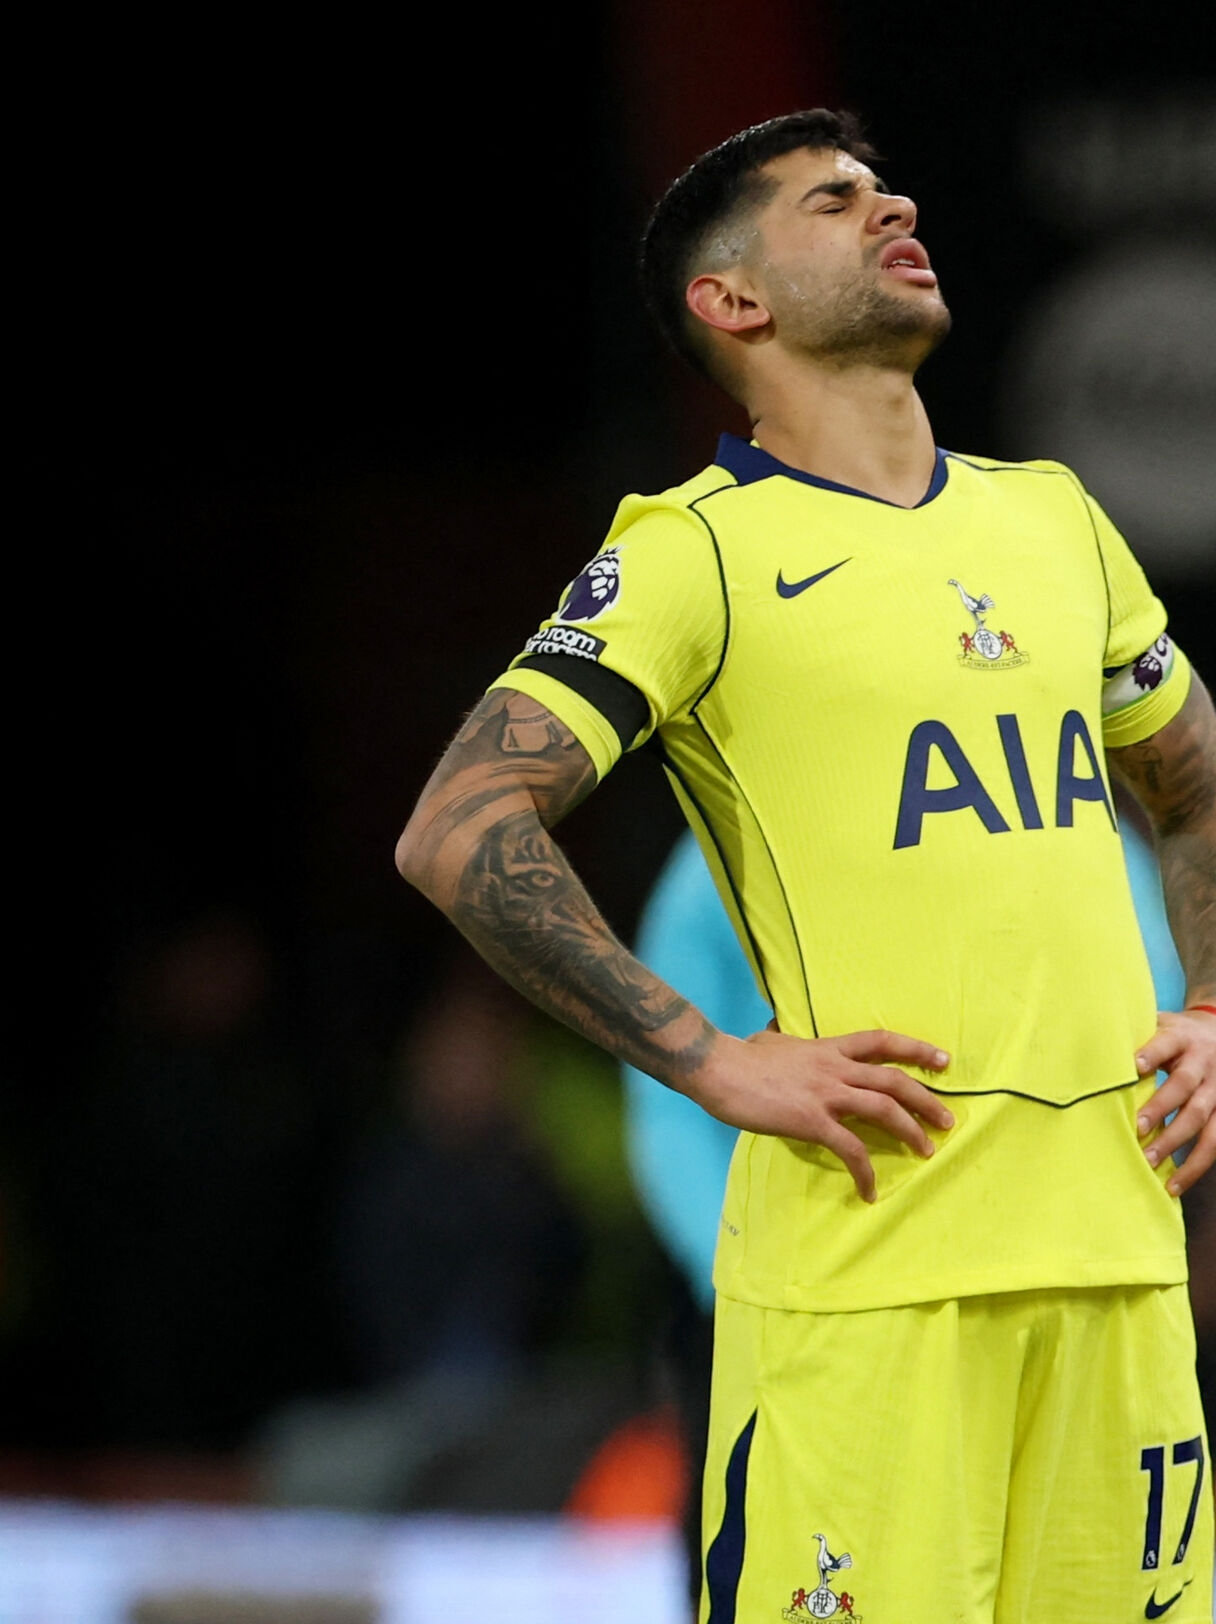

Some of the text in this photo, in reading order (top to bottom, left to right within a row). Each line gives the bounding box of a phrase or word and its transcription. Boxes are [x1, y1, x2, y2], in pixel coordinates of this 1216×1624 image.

[546, 627, 597, 652] room
[893, 709, 1119, 850] AIA
[1141, 1435, 1204, 1570] 17
